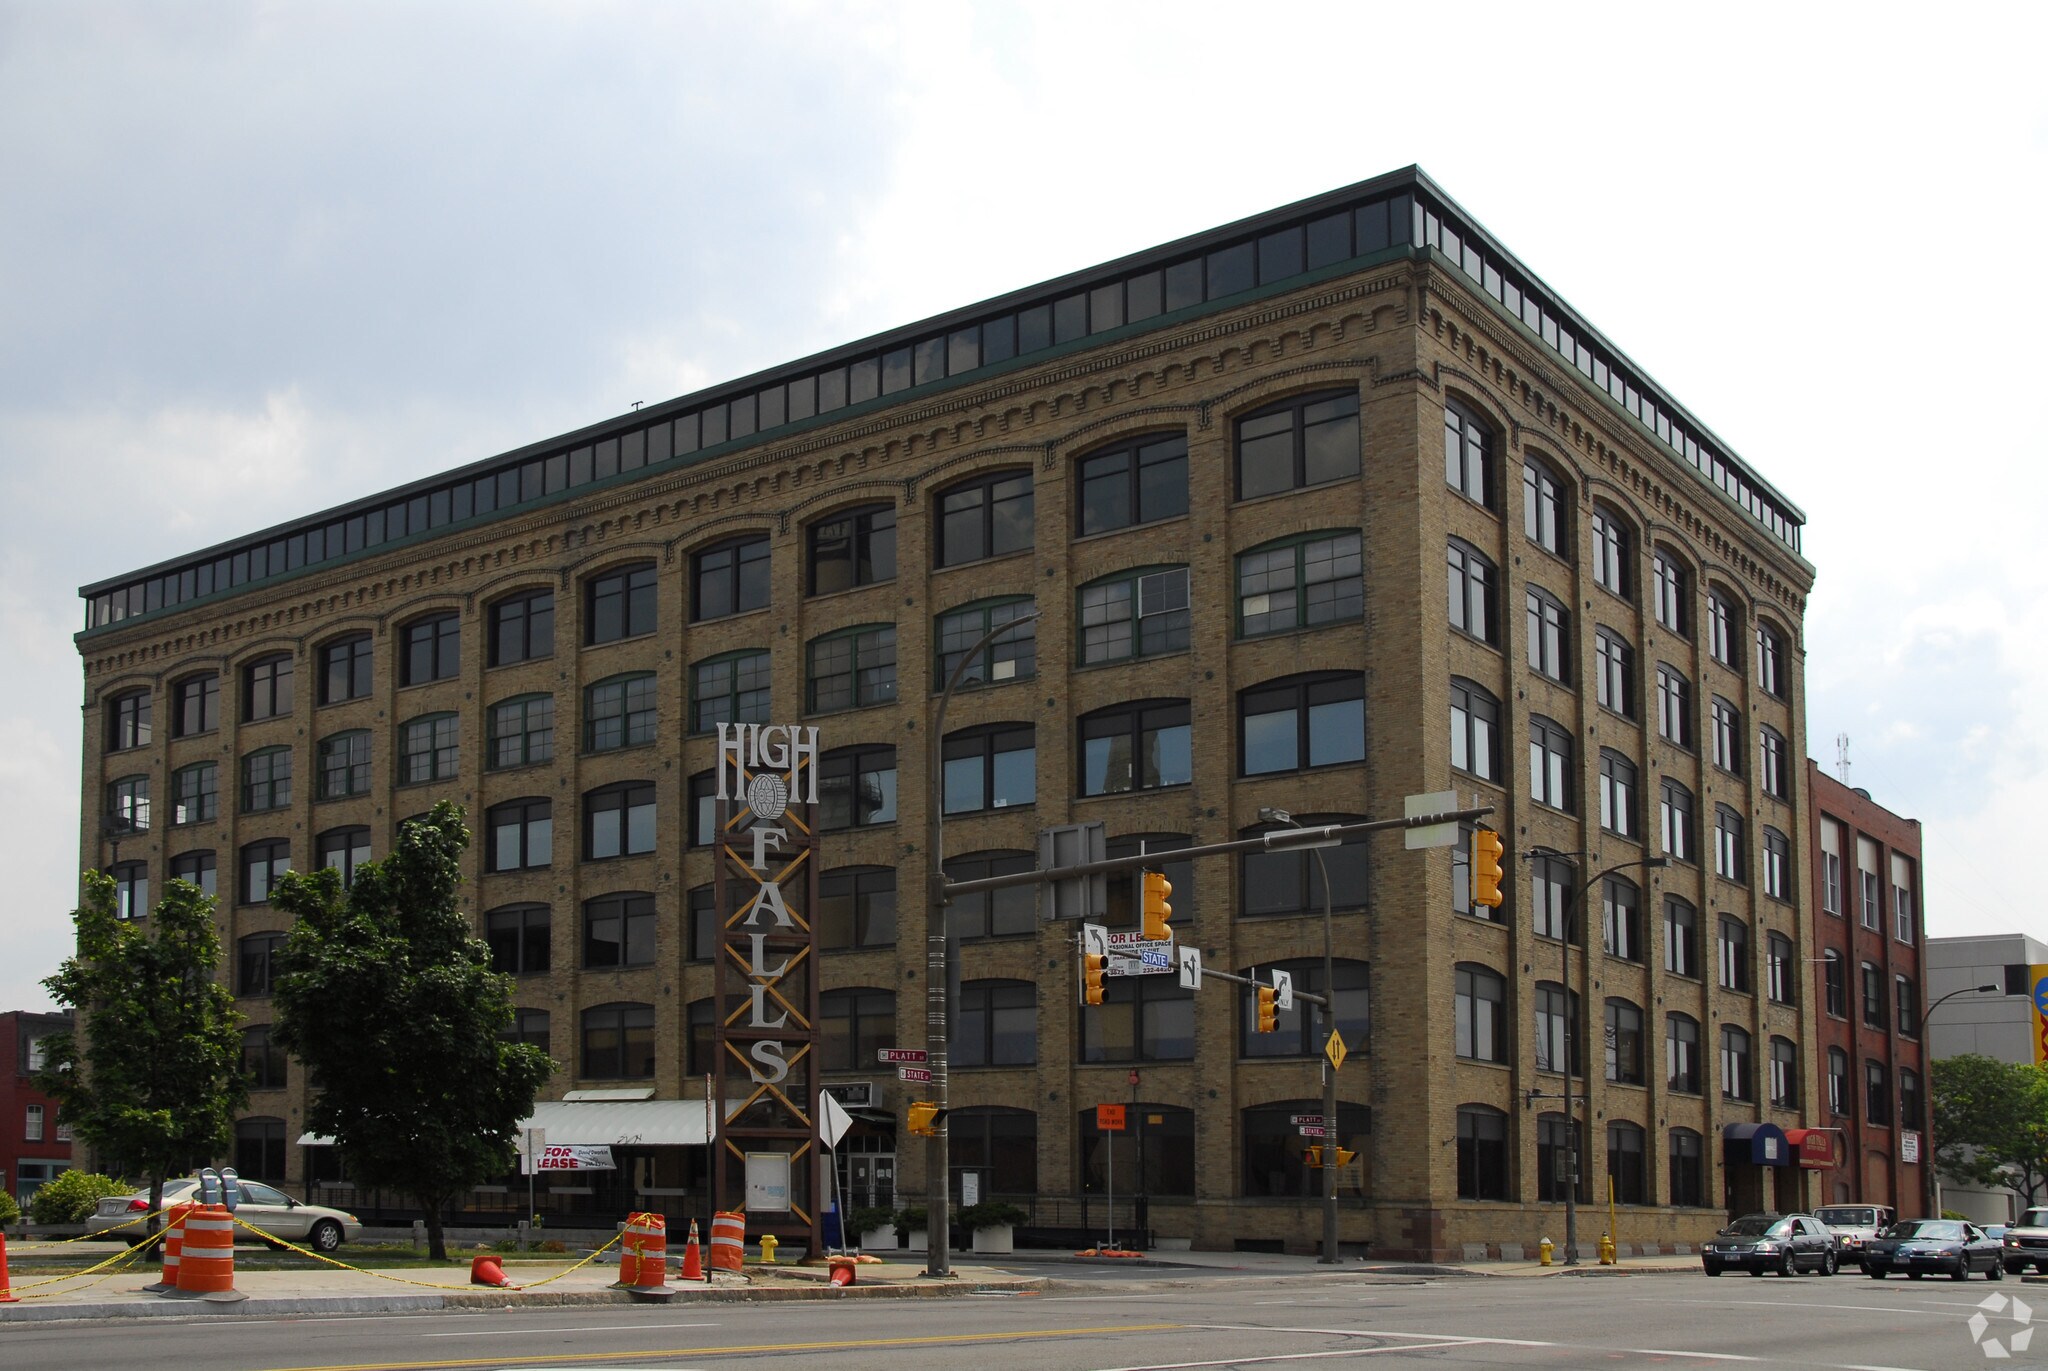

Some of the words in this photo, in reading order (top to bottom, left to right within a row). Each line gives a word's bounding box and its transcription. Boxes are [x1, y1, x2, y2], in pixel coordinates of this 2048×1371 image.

[716, 722, 820, 804] HIGH
[743, 827, 794, 1084] FALLS
[1143, 952, 1166, 966] STATE
[890, 1051, 916, 1060] PLATT
[907, 1070, 924, 1079] STATE
[544, 1147, 572, 1157] FOR
[537, 1158, 578, 1168] LEASE
